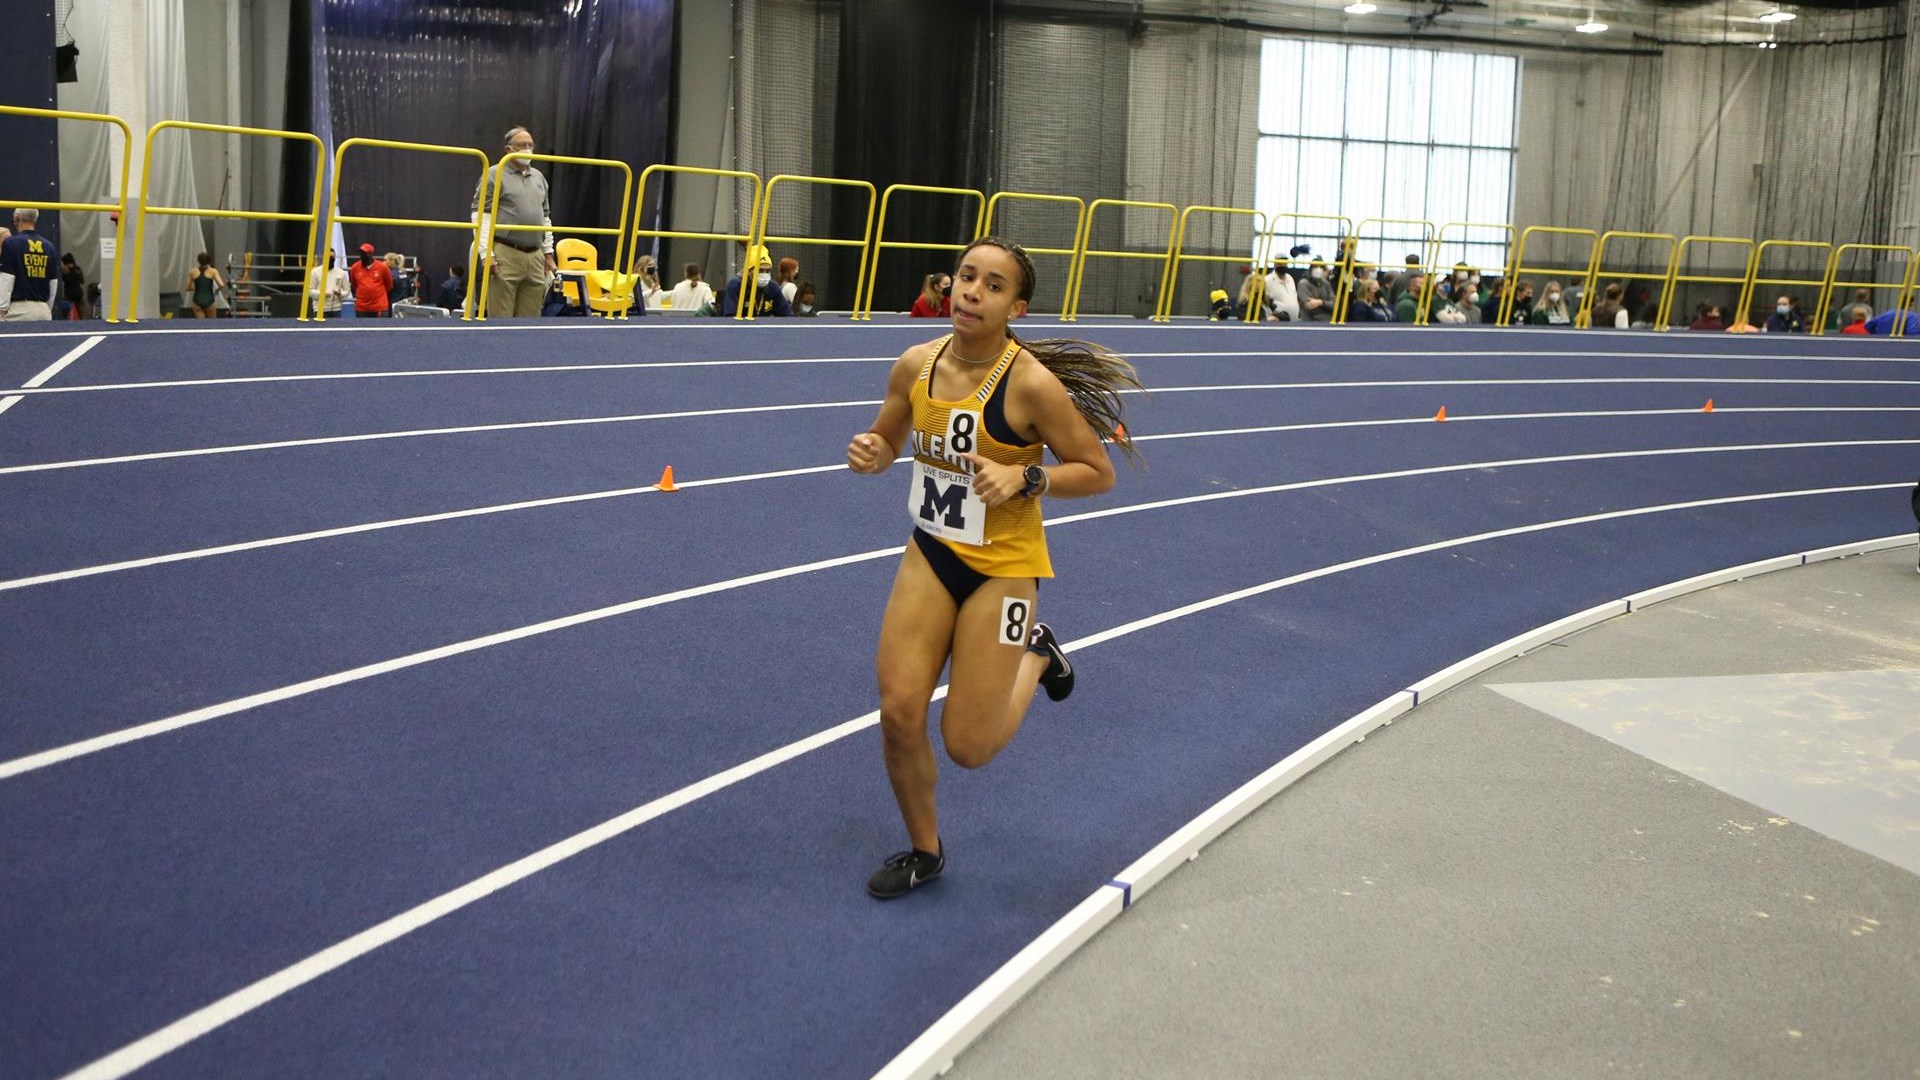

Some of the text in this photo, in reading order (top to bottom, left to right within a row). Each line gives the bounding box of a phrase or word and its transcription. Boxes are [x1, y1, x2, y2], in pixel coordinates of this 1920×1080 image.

[24, 253, 49, 267] EVENT
[28, 239, 44, 253] M
[951, 413, 975, 453] 8
[923, 465, 970, 485] LIVE SPLITS
[919, 475, 968, 530] M
[1005, 601, 1027, 642] 8
